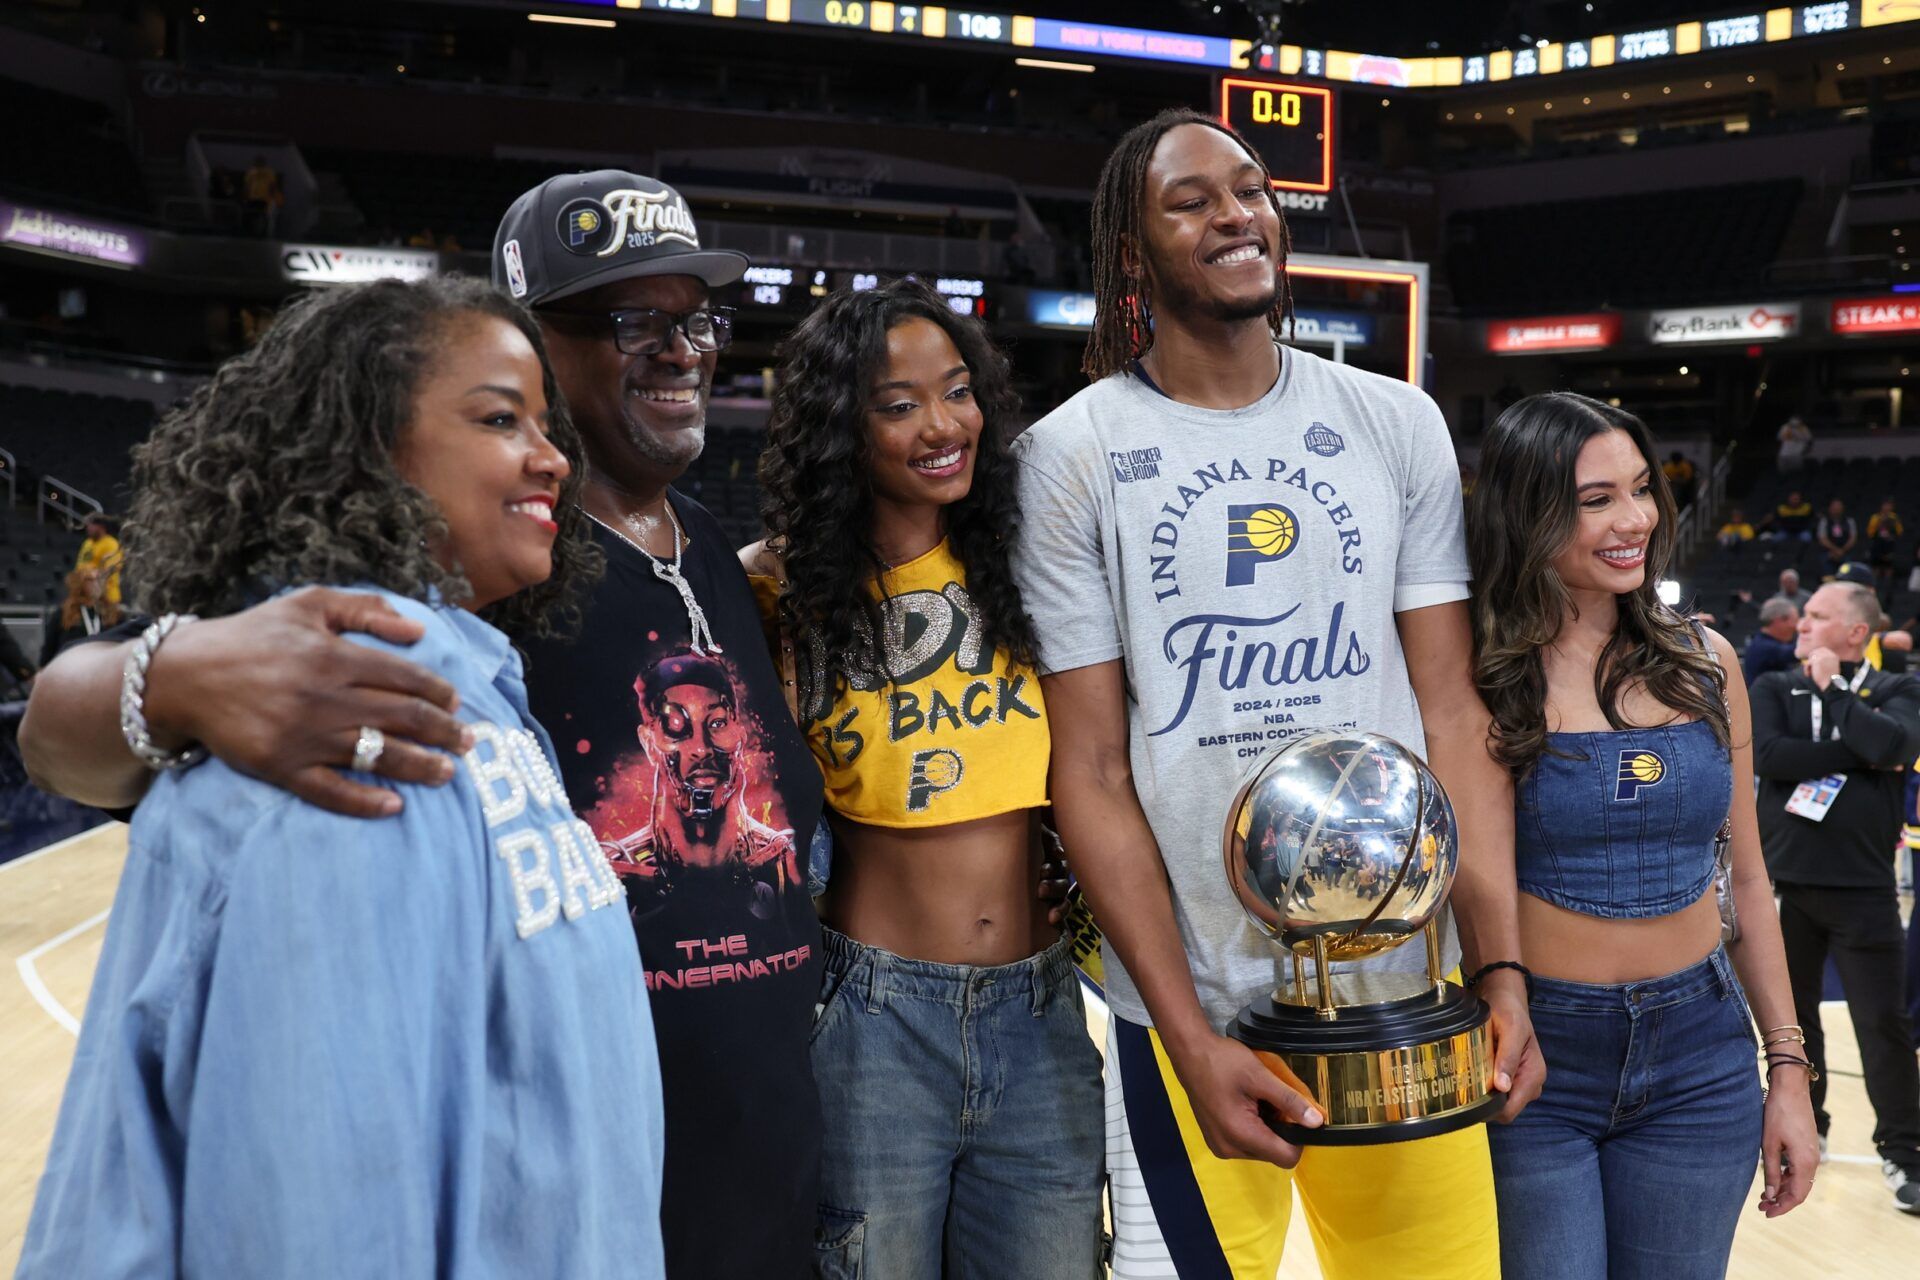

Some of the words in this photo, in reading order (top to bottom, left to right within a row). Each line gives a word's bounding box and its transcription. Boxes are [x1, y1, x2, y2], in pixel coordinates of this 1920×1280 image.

[825, 0, 864, 25] 0.0
[1253, 90, 1300, 125] 0.0
[1277, 193, 1328, 211] SSOT
[597, 189, 699, 256] Finals
[53, 221, 129, 252] DONUTS
[628, 232, 655, 248] 2025
[1836, 305, 1902, 325] STEAK
[1653, 316, 1743, 339] KeyBank
[1305, 432, 1343, 448] EASTERN
[1127, 447, 1162, 466] LOCKER
[1131, 463, 1160, 481] ROOM
[1151, 458, 1253, 604] INDIANA
[1264, 458, 1363, 575] PACERS
[1148, 601, 1371, 737] Finals
[886, 674, 1042, 744] BACK
[1233, 699, 1273, 712] 2024
[1284, 695, 1322, 708] 2025
[1263, 714, 1295, 724] NBA
[1198, 731, 1263, 747] EASTERN
[675, 934, 749, 961] THE
[1346, 1090, 1373, 1109] NBA
[1375, 1082, 1429, 1106] EASTERN
